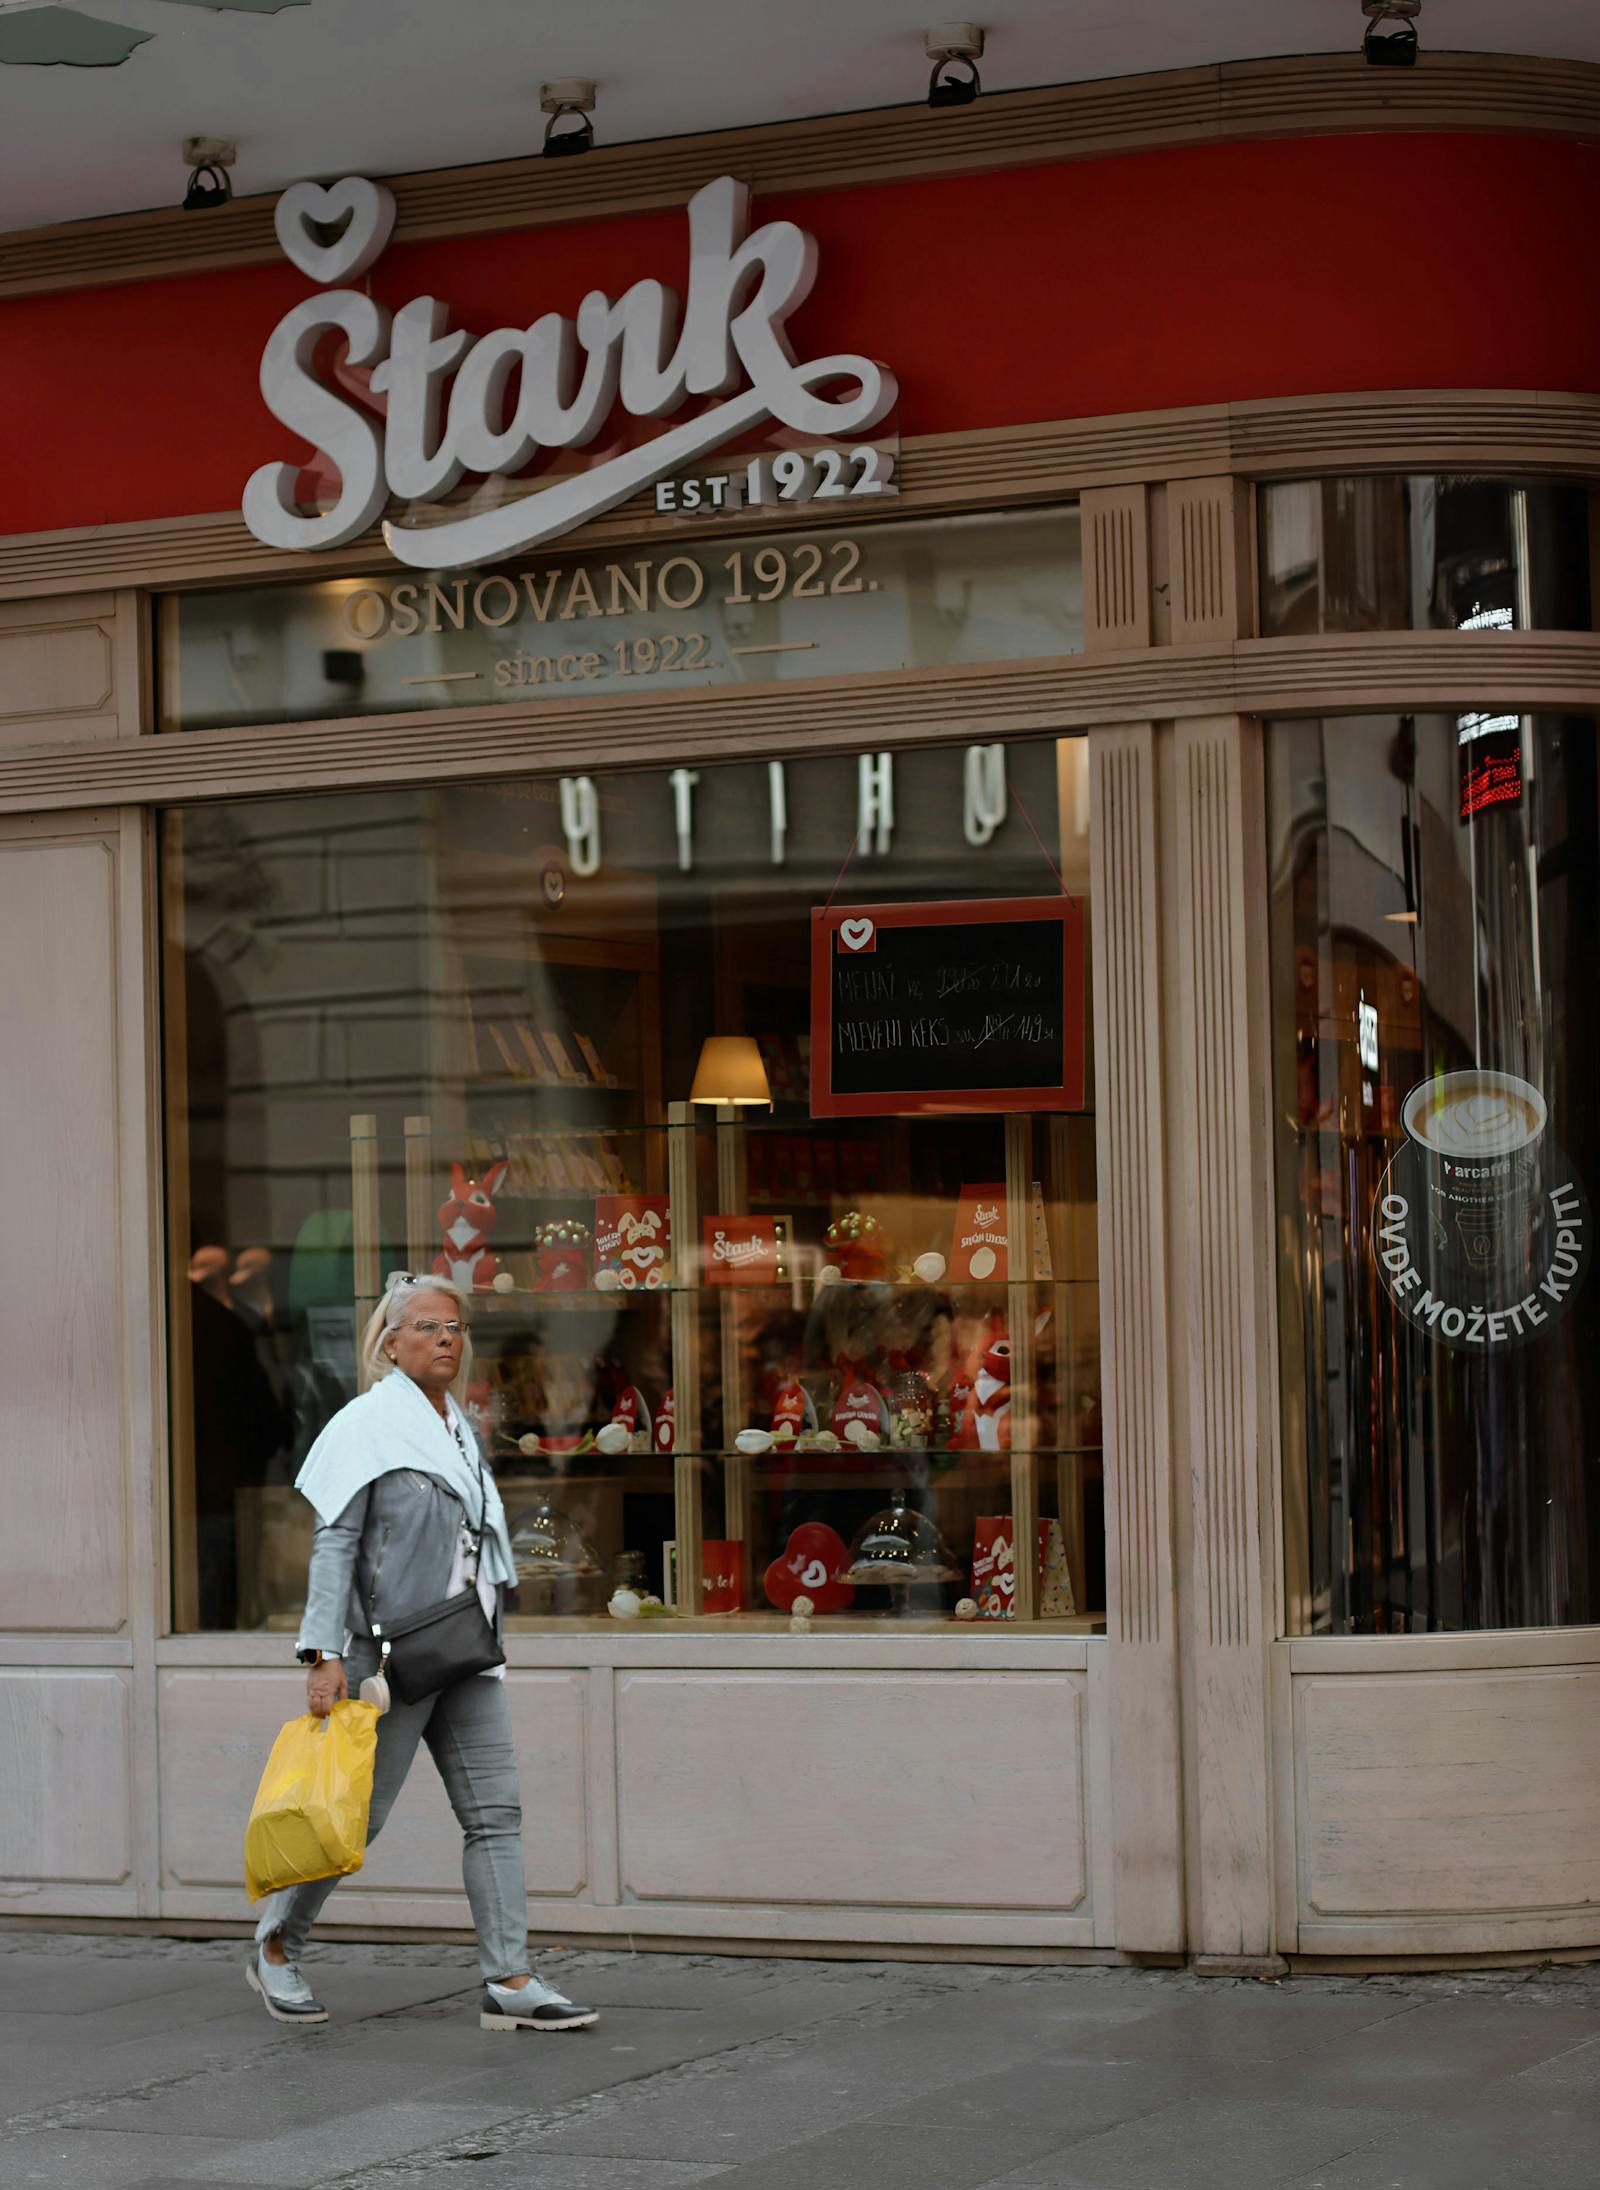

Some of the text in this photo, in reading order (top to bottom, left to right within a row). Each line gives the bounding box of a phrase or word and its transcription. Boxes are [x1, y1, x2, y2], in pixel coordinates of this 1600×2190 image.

[656, 446, 897, 512] EST 1922
[343, 540, 879, 640] OSNOVANO 1922.
[494, 648, 604, 686] since
[1379, 1182, 1583, 1343] OVDE MOŽETE KUPITI
